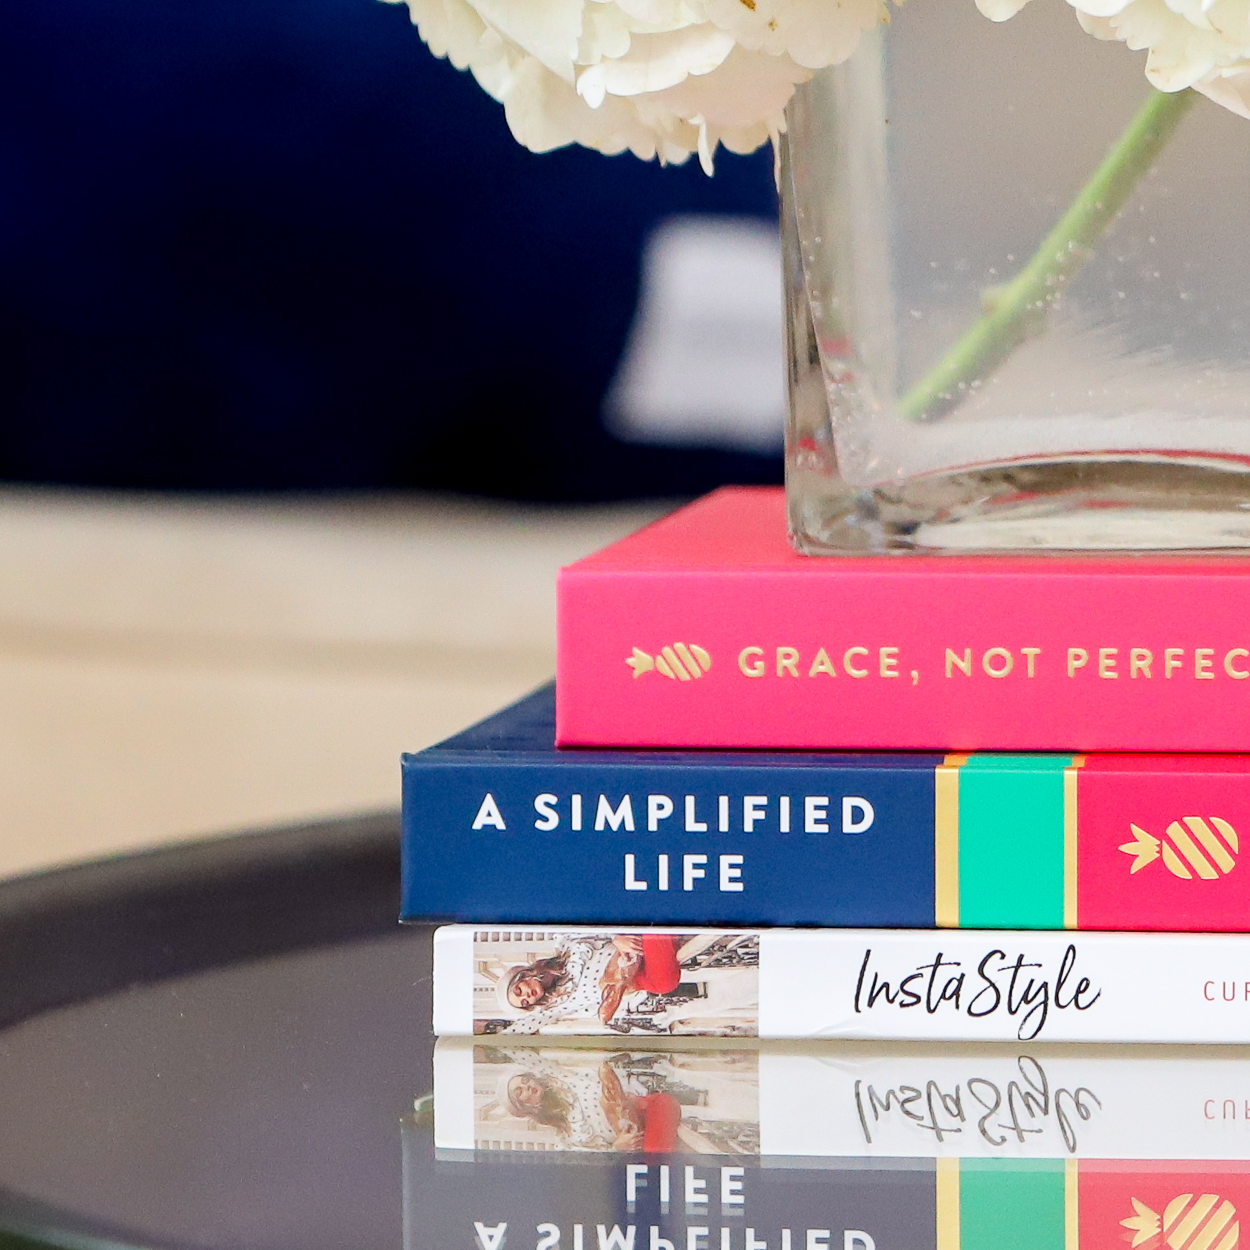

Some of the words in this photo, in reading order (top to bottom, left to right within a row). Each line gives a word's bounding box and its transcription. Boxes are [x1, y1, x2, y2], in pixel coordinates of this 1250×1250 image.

[737, 646, 921, 686] GRACE,
[944, 646, 1042, 680] NOT
[471, 793, 507, 831] A
[534, 793, 876, 835] SIMPLIFIED
[624, 854, 744, 892] LIFE
